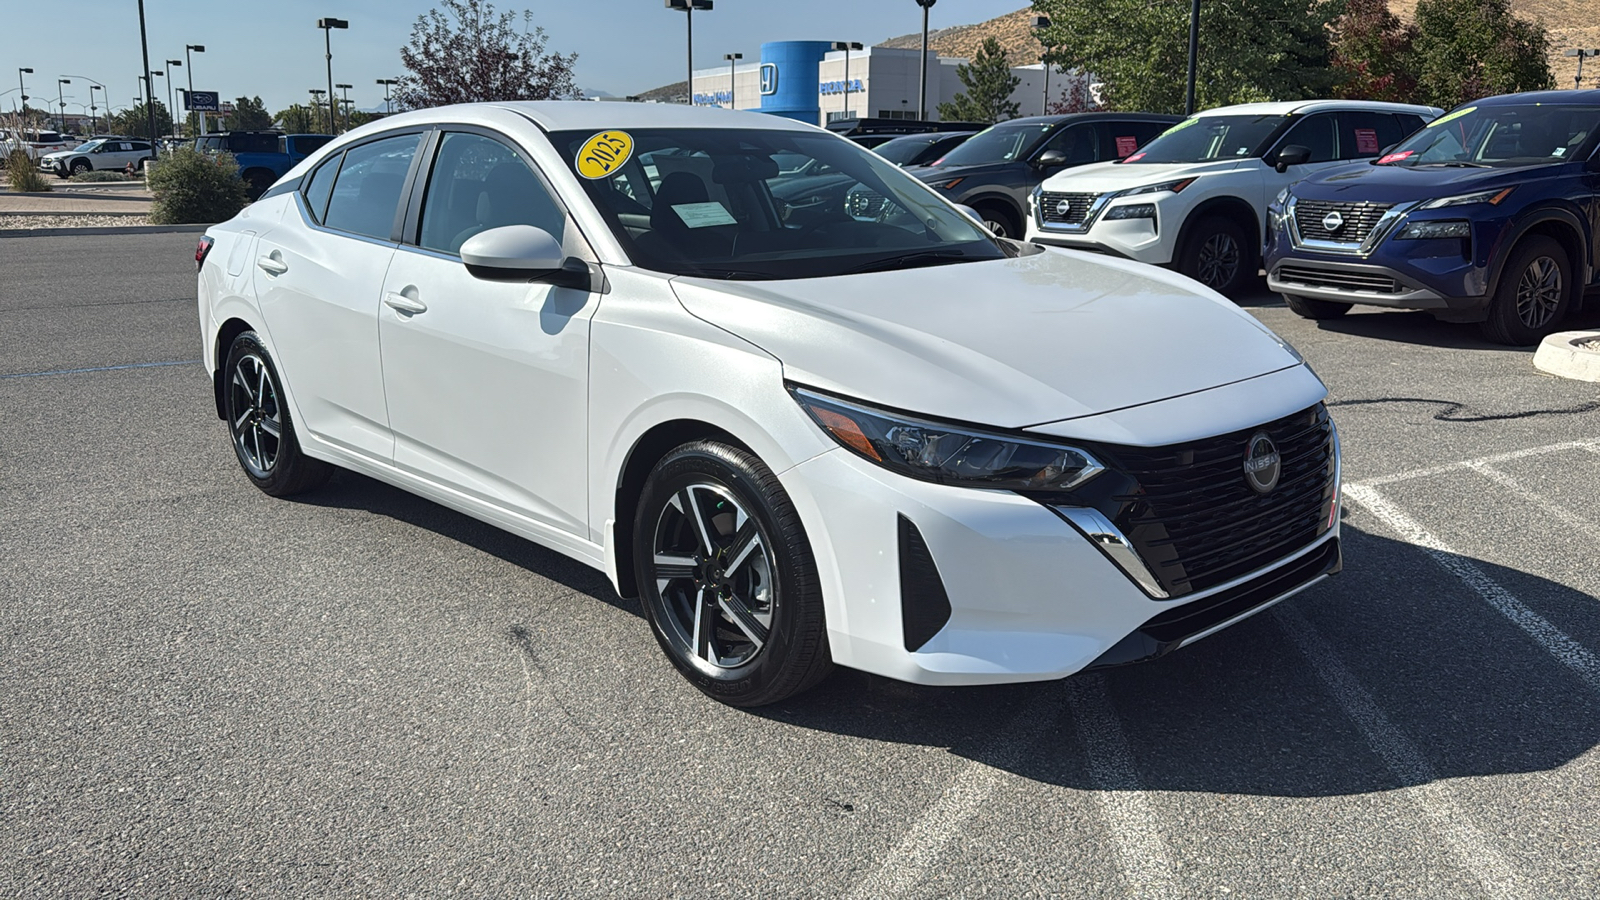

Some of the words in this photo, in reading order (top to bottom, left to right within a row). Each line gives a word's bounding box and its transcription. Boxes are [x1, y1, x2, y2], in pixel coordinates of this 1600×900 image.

[819, 79, 863, 93] HONDA
[585, 134, 626, 172] 2025
[1246, 452, 1280, 472] NISSAN
